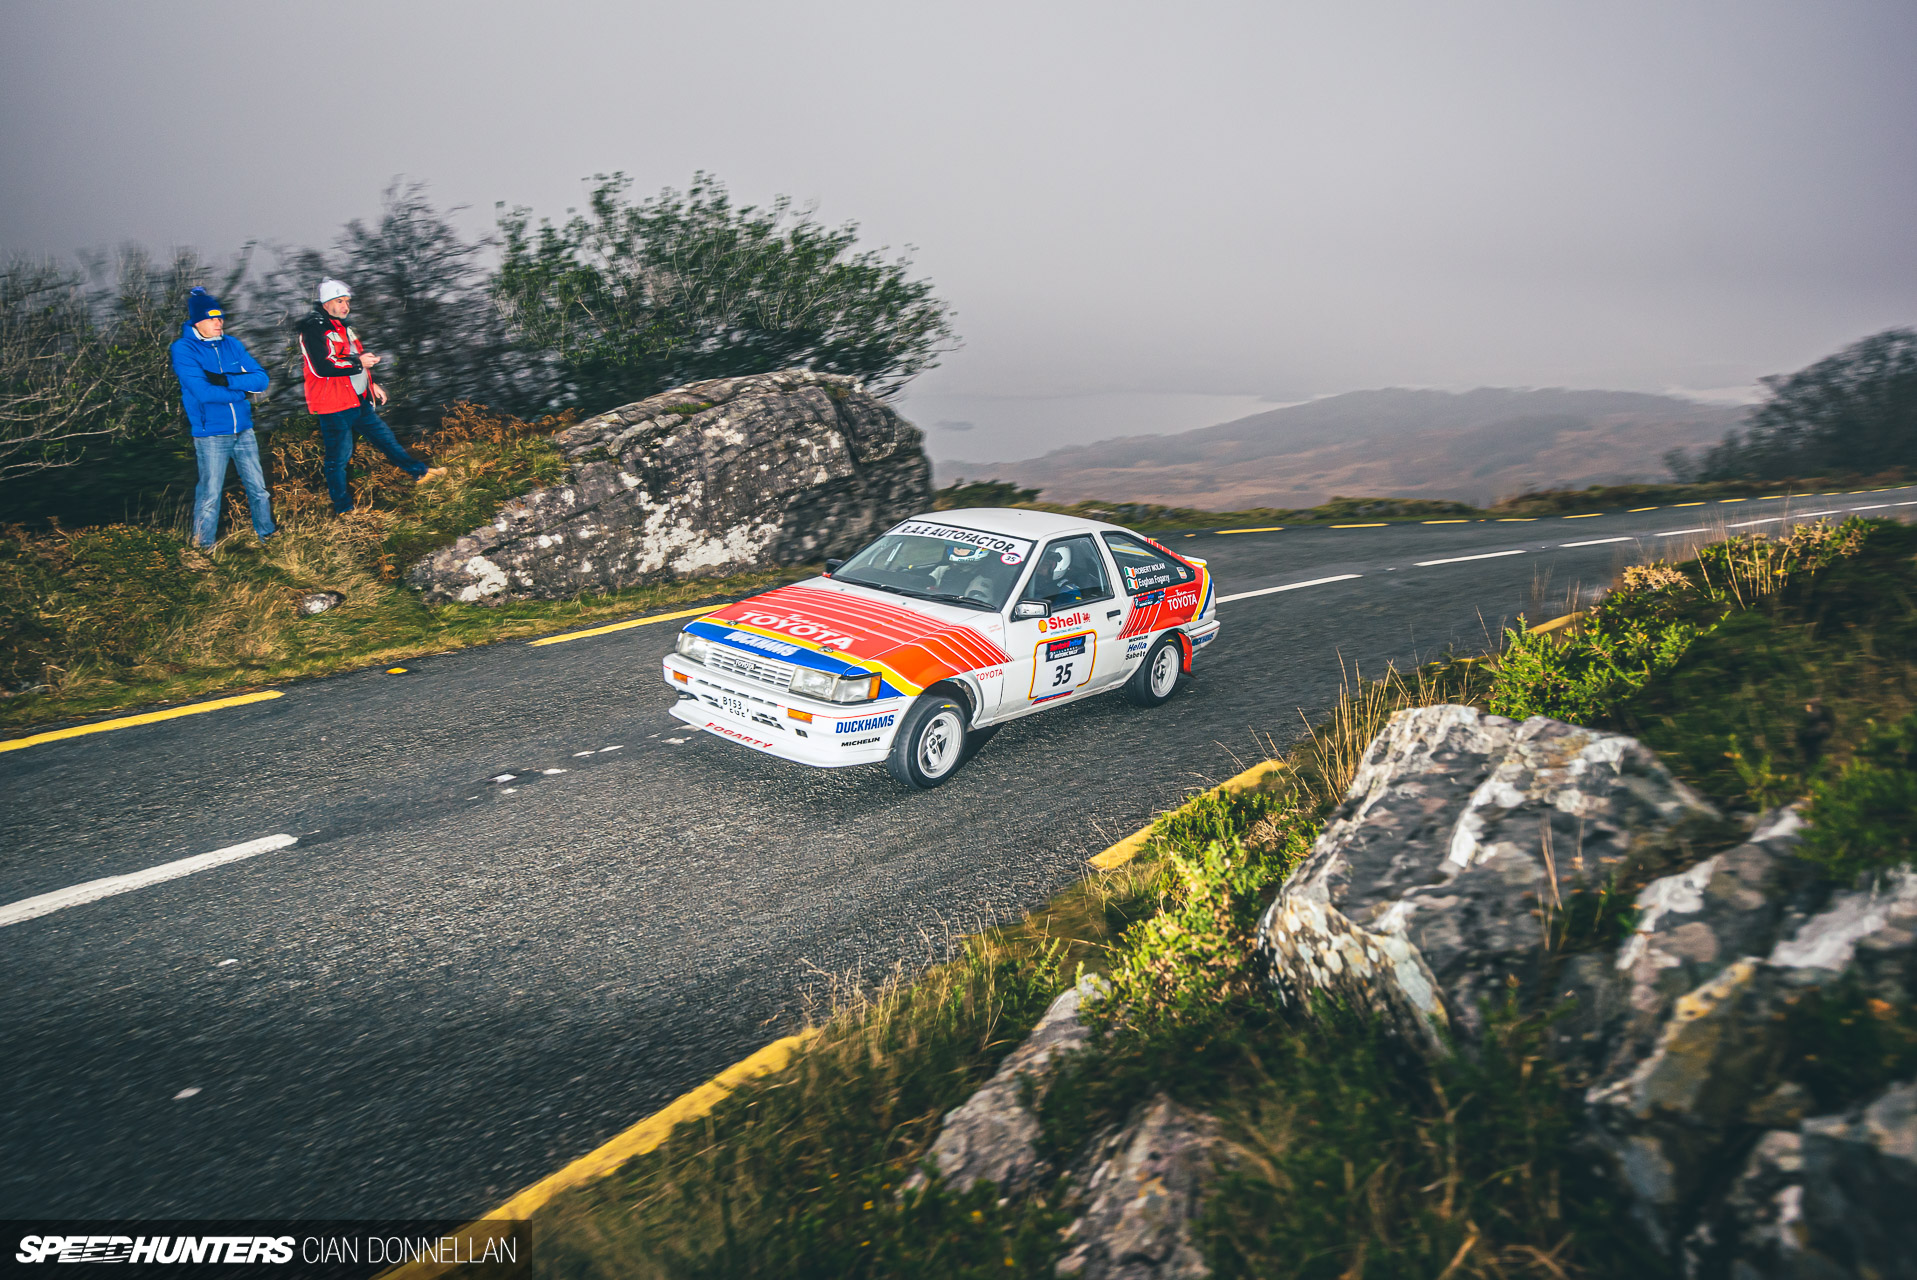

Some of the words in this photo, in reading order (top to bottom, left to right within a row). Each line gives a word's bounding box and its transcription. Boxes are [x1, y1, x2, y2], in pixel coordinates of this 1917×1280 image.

[928, 527, 1016, 553] AUTOFACTOR
[1004, 555, 1016, 563] 35
[1167, 593, 1198, 611] TOYOTA
[1048, 612, 1082, 630] Shell
[735, 611, 855, 650] TOYOTA
[724, 631, 803, 657] DUCKHAMS
[1127, 641, 1147, 652] Hella
[1125, 650, 1146, 661] Sabelt
[734, 659, 756, 671] TOYOTA
[975, 668, 1003, 681] TOYOTA
[1052, 662, 1074, 687] 35
[722, 696, 742, 710] B153
[835, 715, 895, 734] DUCKHAMS
[705, 722, 774, 749] FOGARTY
[840, 736, 881, 747] MICHELIN
